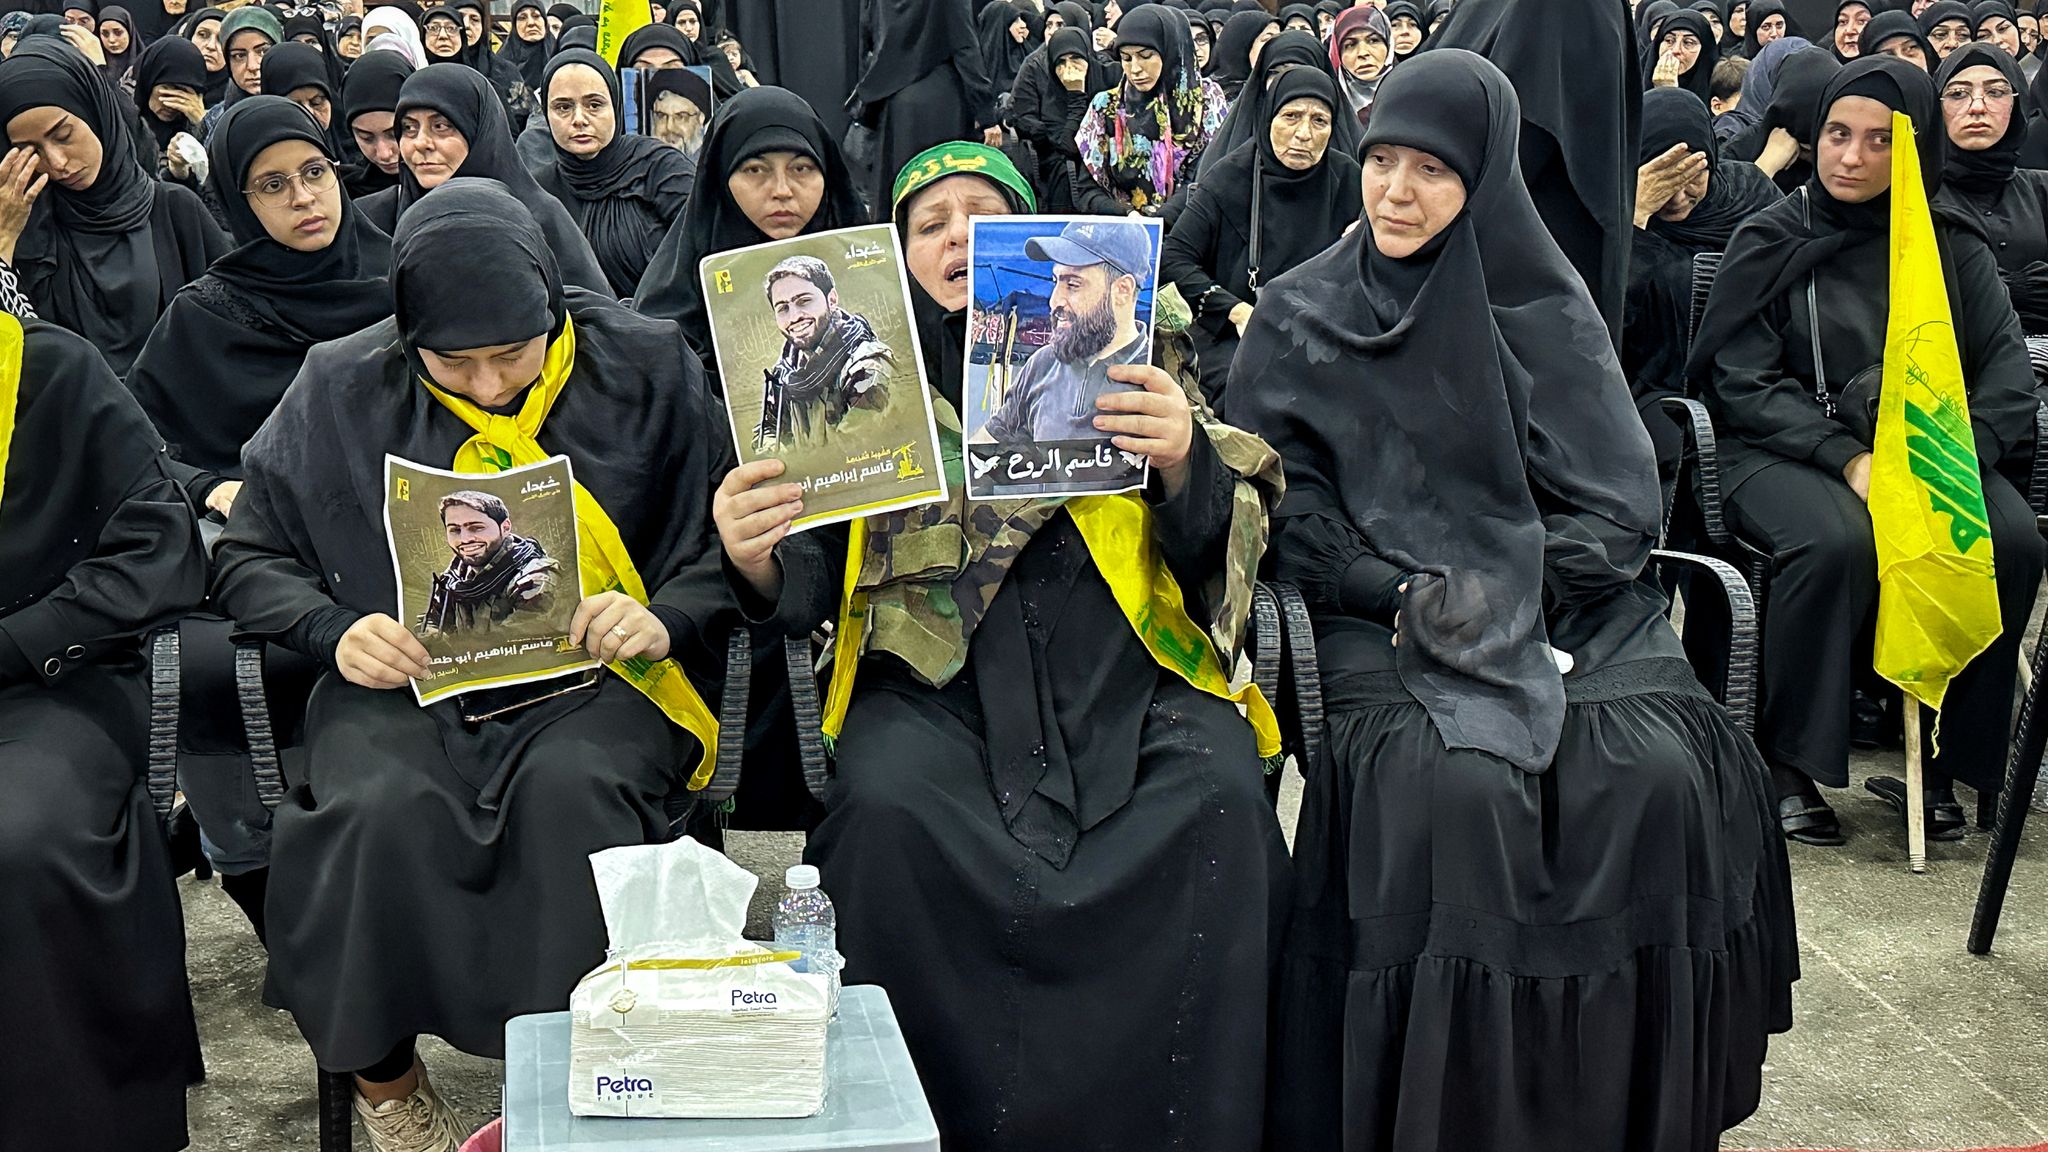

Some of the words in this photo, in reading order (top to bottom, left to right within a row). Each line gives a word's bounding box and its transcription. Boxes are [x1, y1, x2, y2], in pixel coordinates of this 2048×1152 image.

[860, 459, 894, 482] قاسم
[1007, 448, 1061, 480] الروح
[1064, 444, 1113, 478] قاسم
[520, 475, 560, 494] شهداء
[519, 640, 553, 655] قاسم
[731, 989, 777, 1006] Petra
[597, 1076, 652, 1095] Petra
